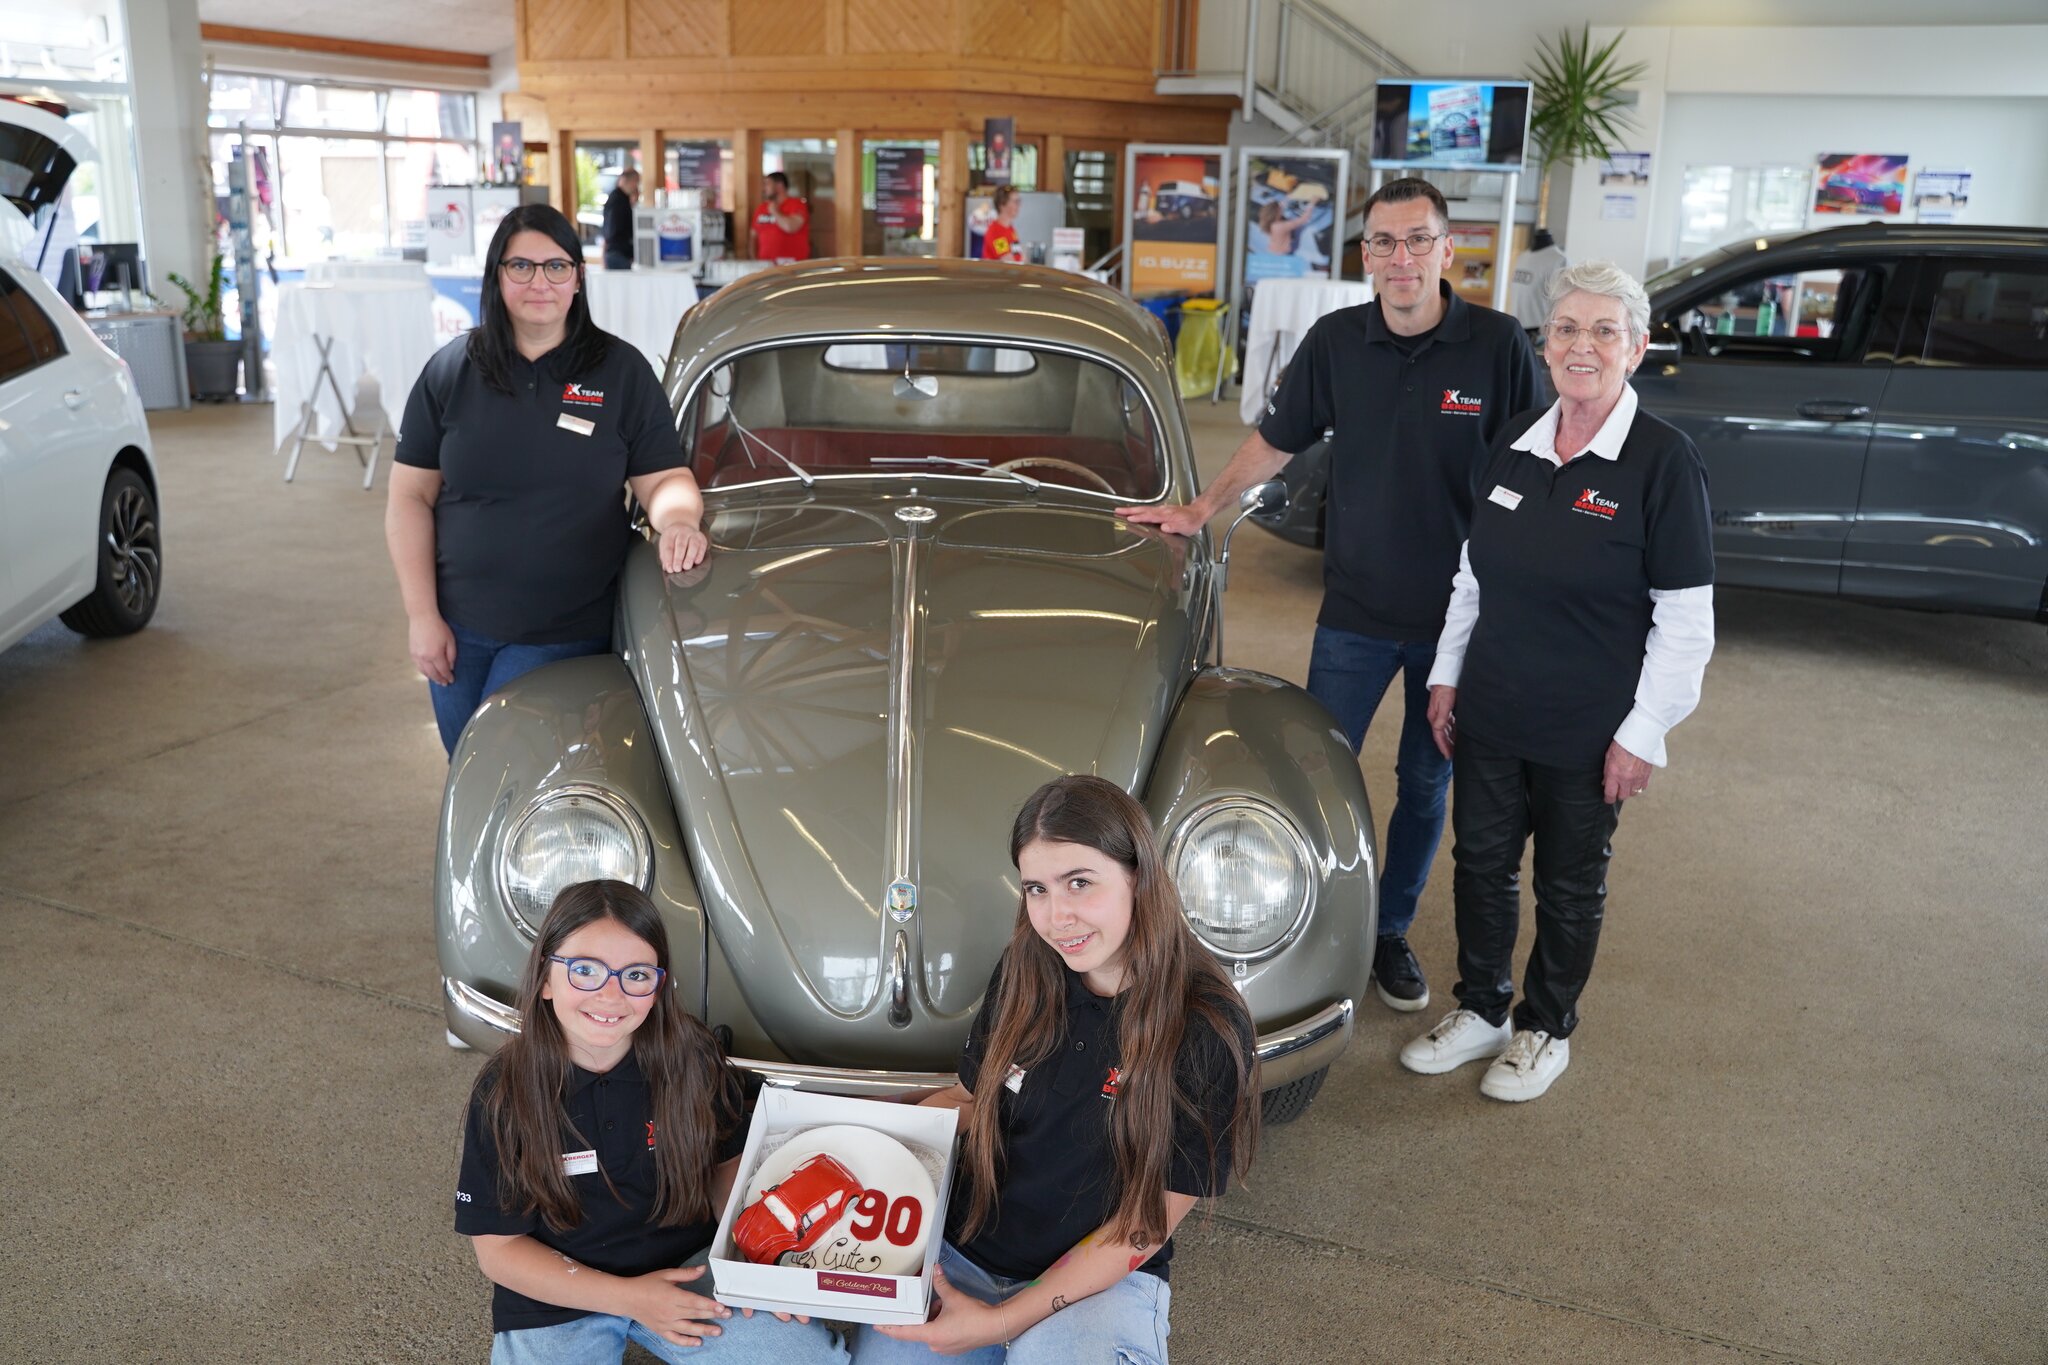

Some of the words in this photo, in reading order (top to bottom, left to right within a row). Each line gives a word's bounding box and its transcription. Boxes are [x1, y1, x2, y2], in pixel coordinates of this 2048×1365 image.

[1159, 257, 1209, 271] BUZZ
[581, 389, 604, 398] TEAM
[1440, 402, 1481, 412] BERGER
[1459, 396, 1482, 405] TEAM
[1573, 500, 1617, 516] BERGER
[1595, 497, 1620, 510] TEAM
[850, 1188, 923, 1247] 90
